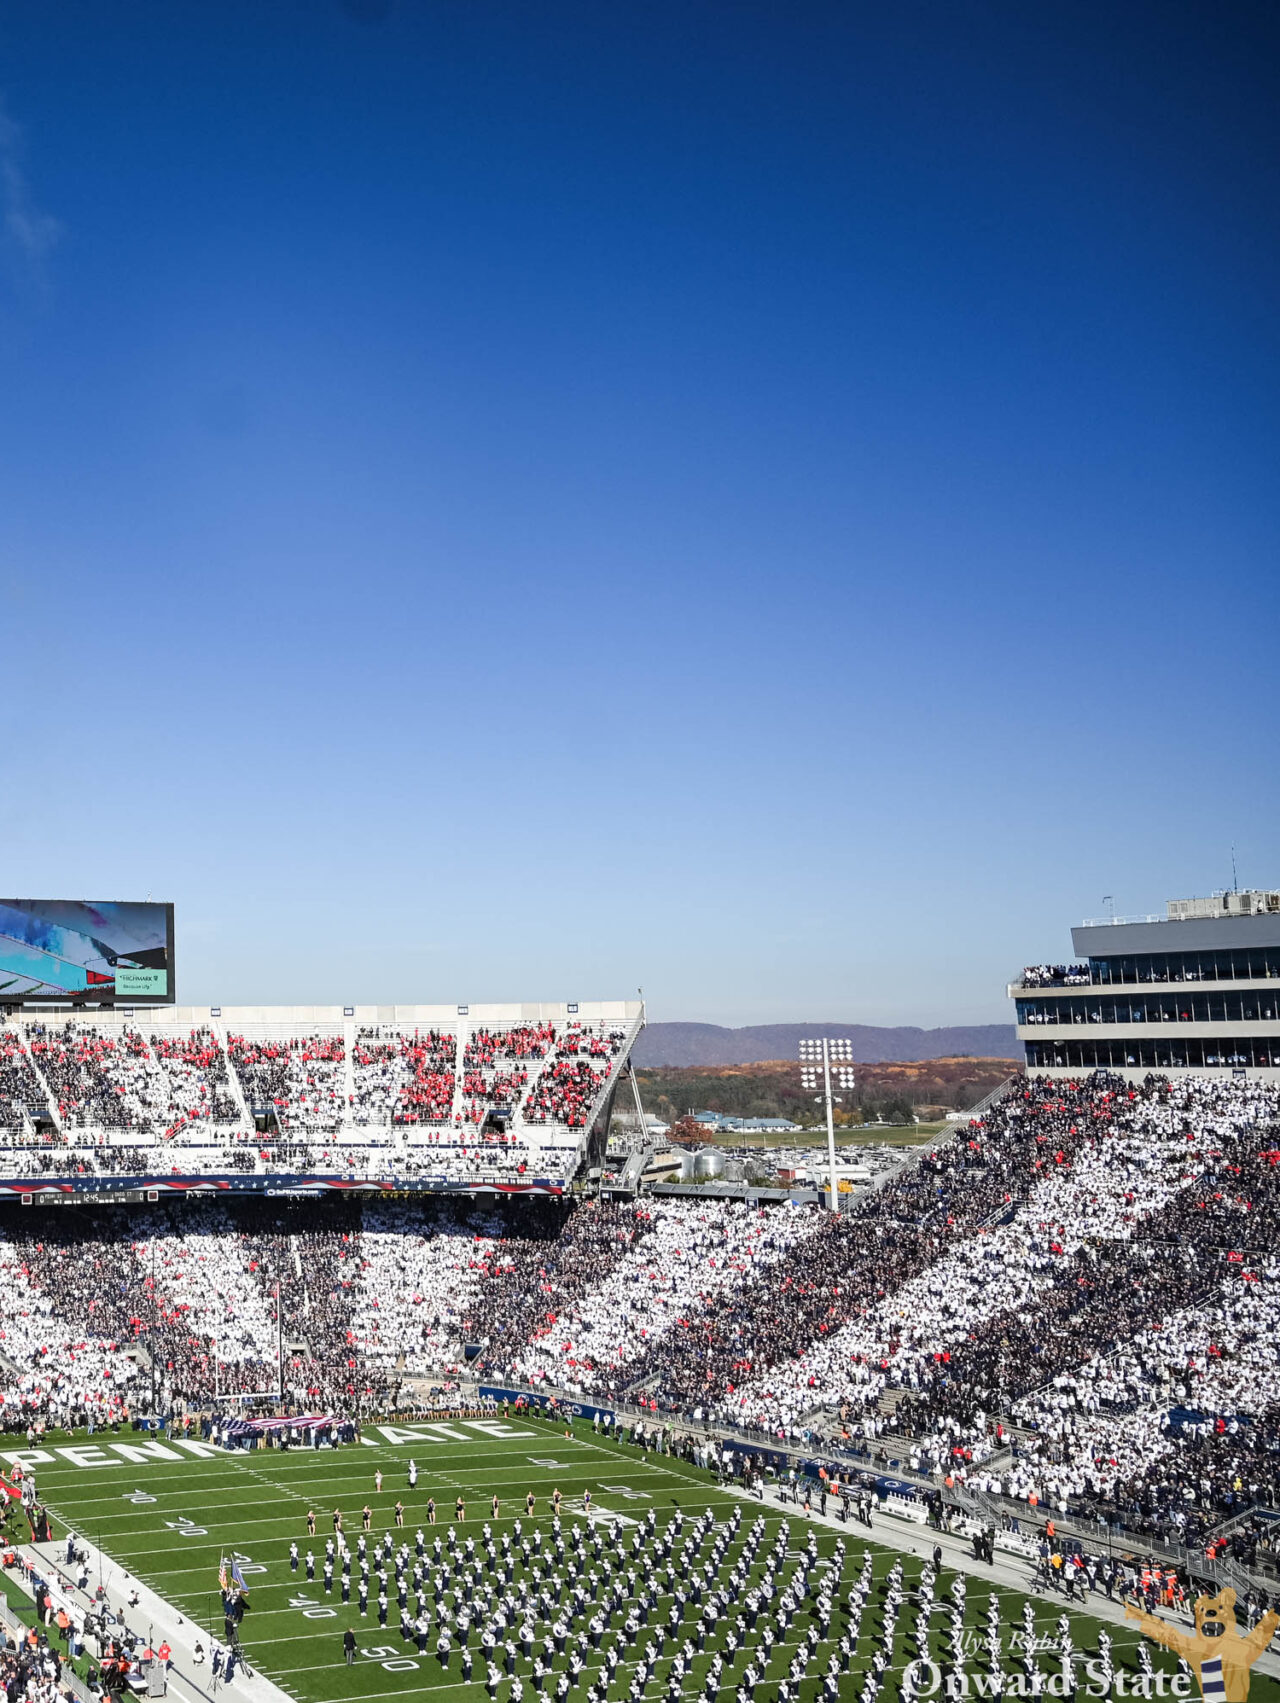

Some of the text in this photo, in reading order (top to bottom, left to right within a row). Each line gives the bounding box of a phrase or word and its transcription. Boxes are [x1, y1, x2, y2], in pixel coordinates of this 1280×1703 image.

[0, 1418, 537, 1472] PENN ATE
[122, 1492, 157, 1504] 10
[165, 1519, 208, 1537] 20
[224, 1554, 268, 1575] 30
[288, 1597, 337, 1618] 40
[360, 1646, 420, 1672] 50
